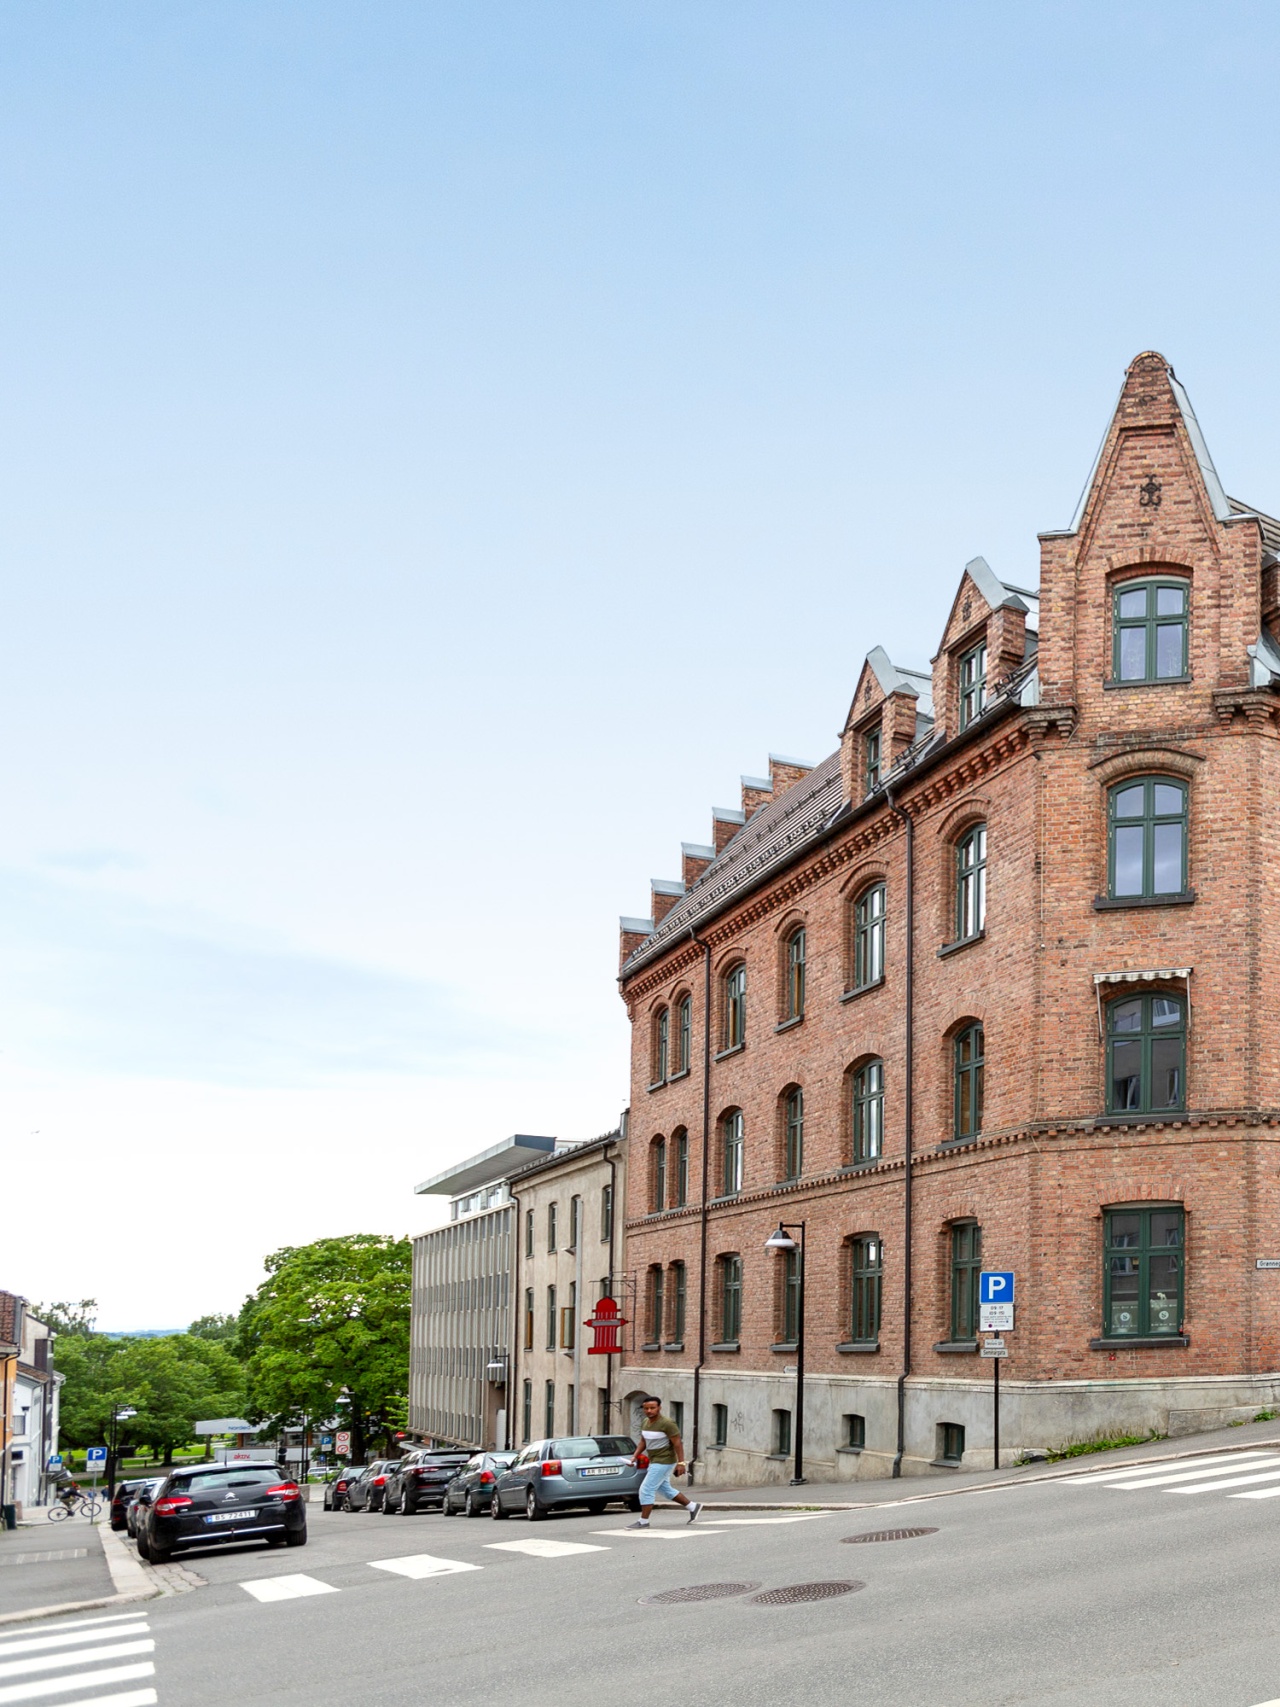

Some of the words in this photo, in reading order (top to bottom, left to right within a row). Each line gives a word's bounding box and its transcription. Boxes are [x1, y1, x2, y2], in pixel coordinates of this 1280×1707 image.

[988, 1276, 1006, 1299] P
[92, 1449, 103, 1460] P
[228, 1511, 252, 1519] 72411
